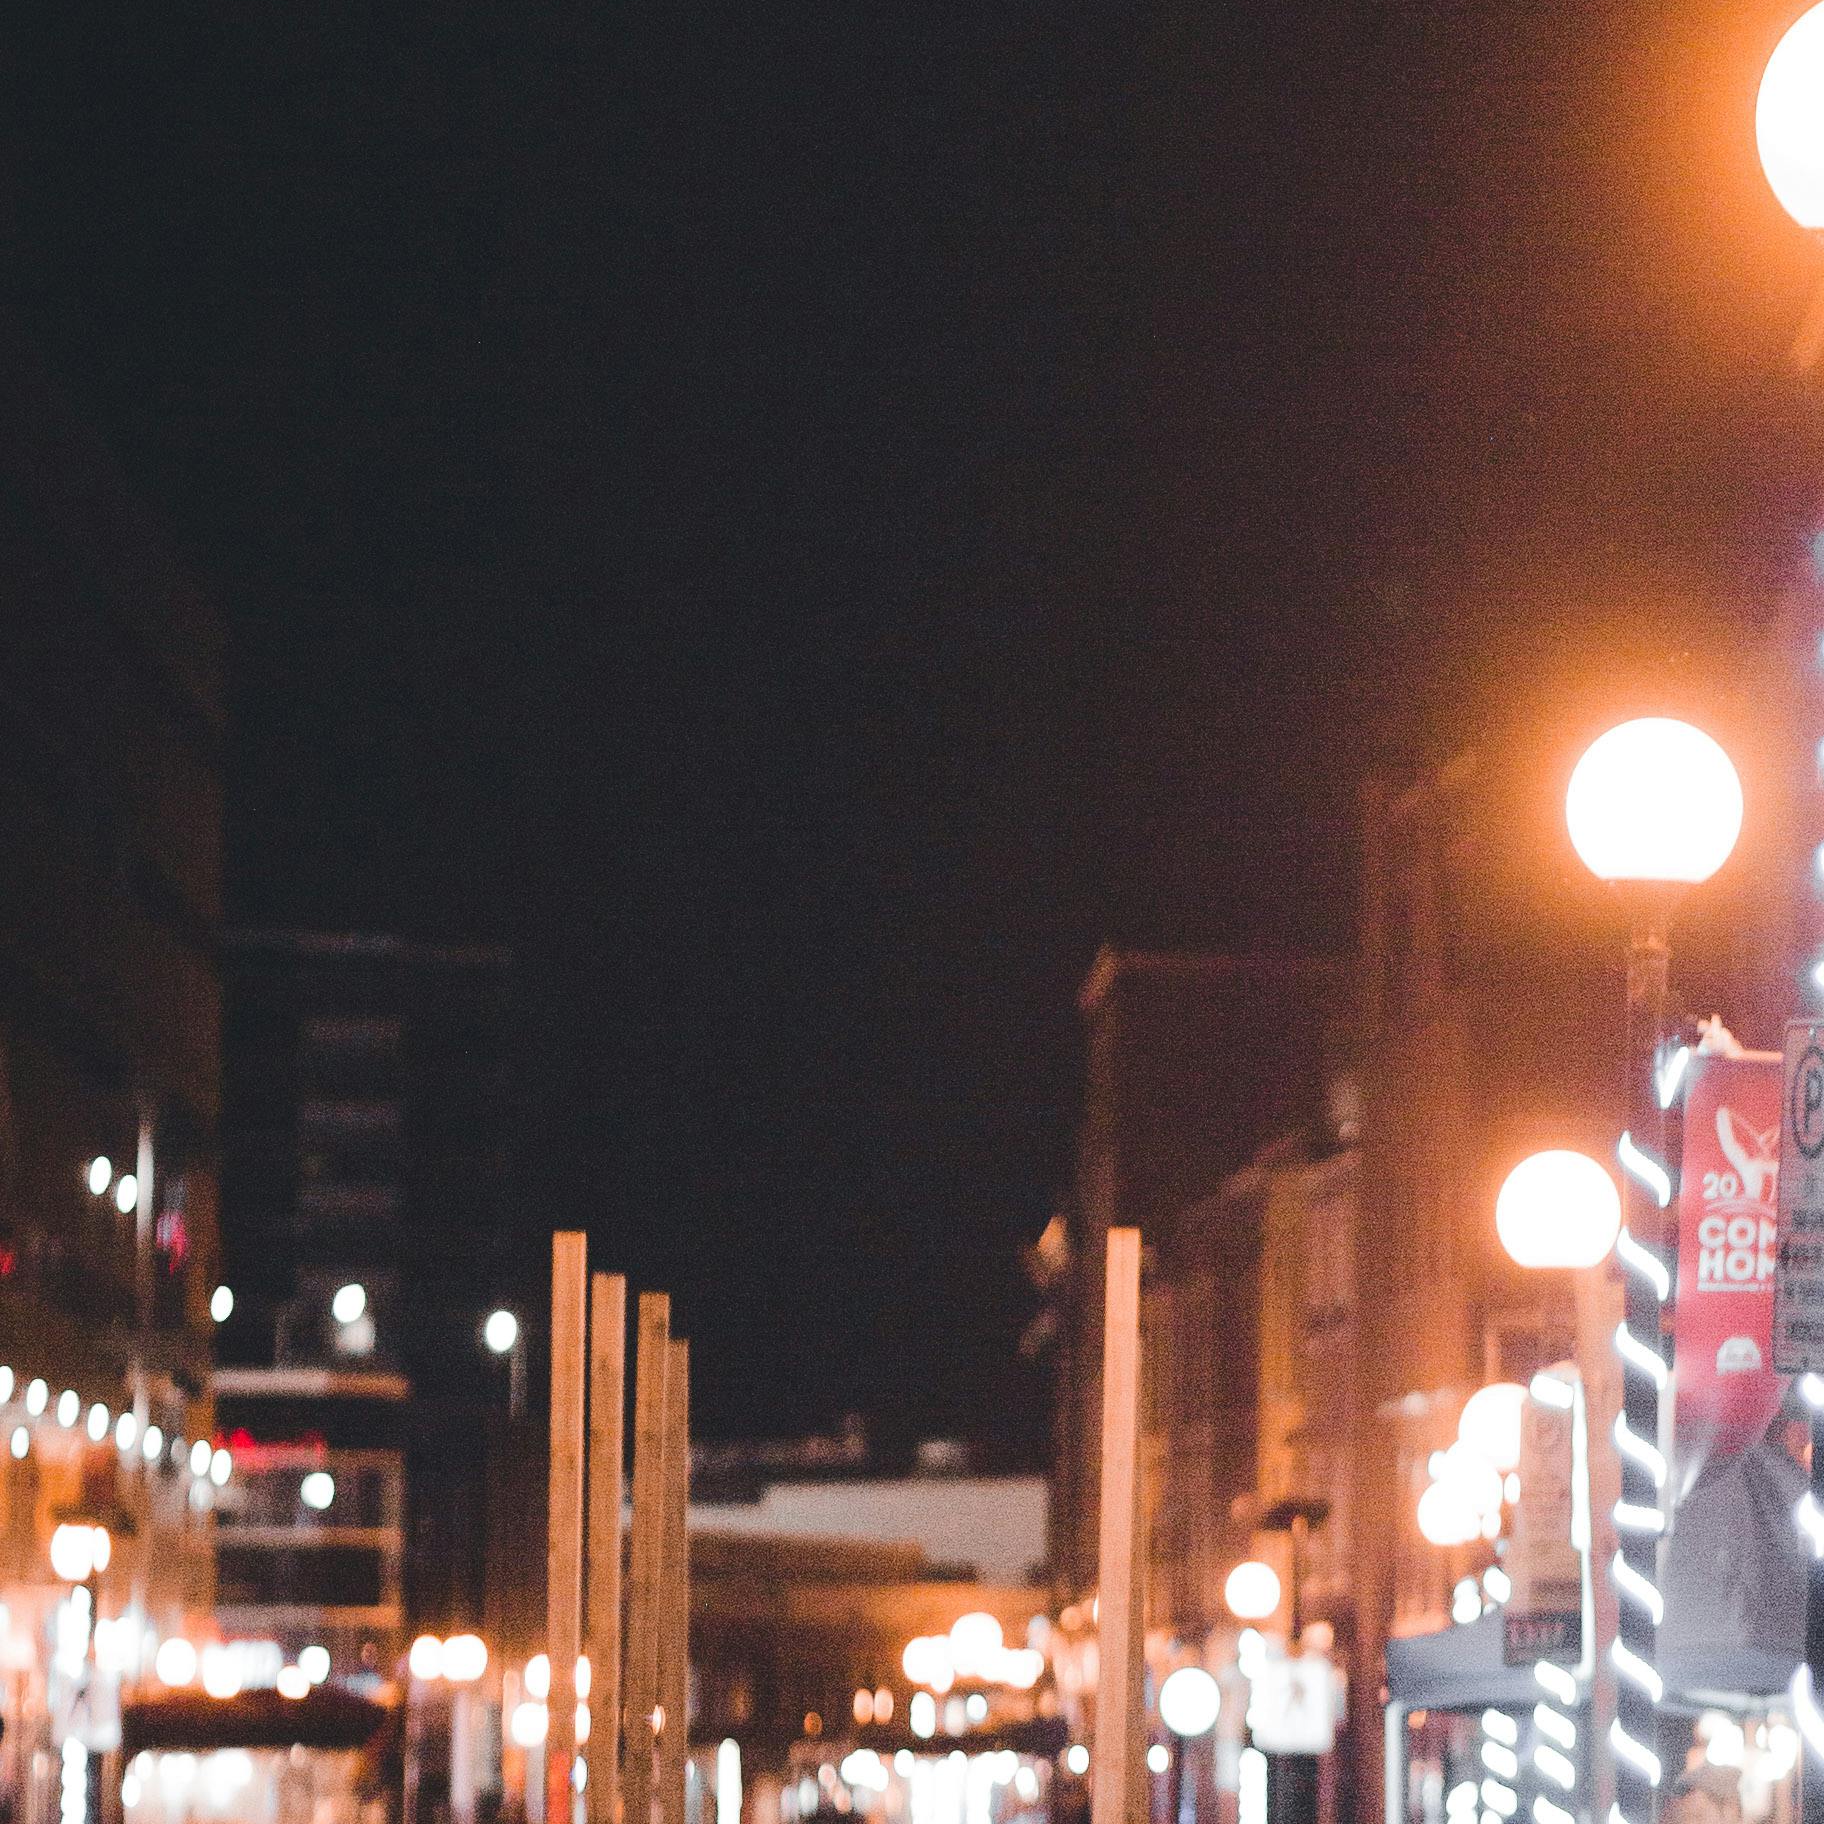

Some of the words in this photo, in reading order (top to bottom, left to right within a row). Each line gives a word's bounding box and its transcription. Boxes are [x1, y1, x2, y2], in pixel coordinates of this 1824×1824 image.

[1702, 1172, 1737, 1200] 20
[1697, 1216, 1778, 1250] COM
[1697, 1247, 1777, 1282] HOM
